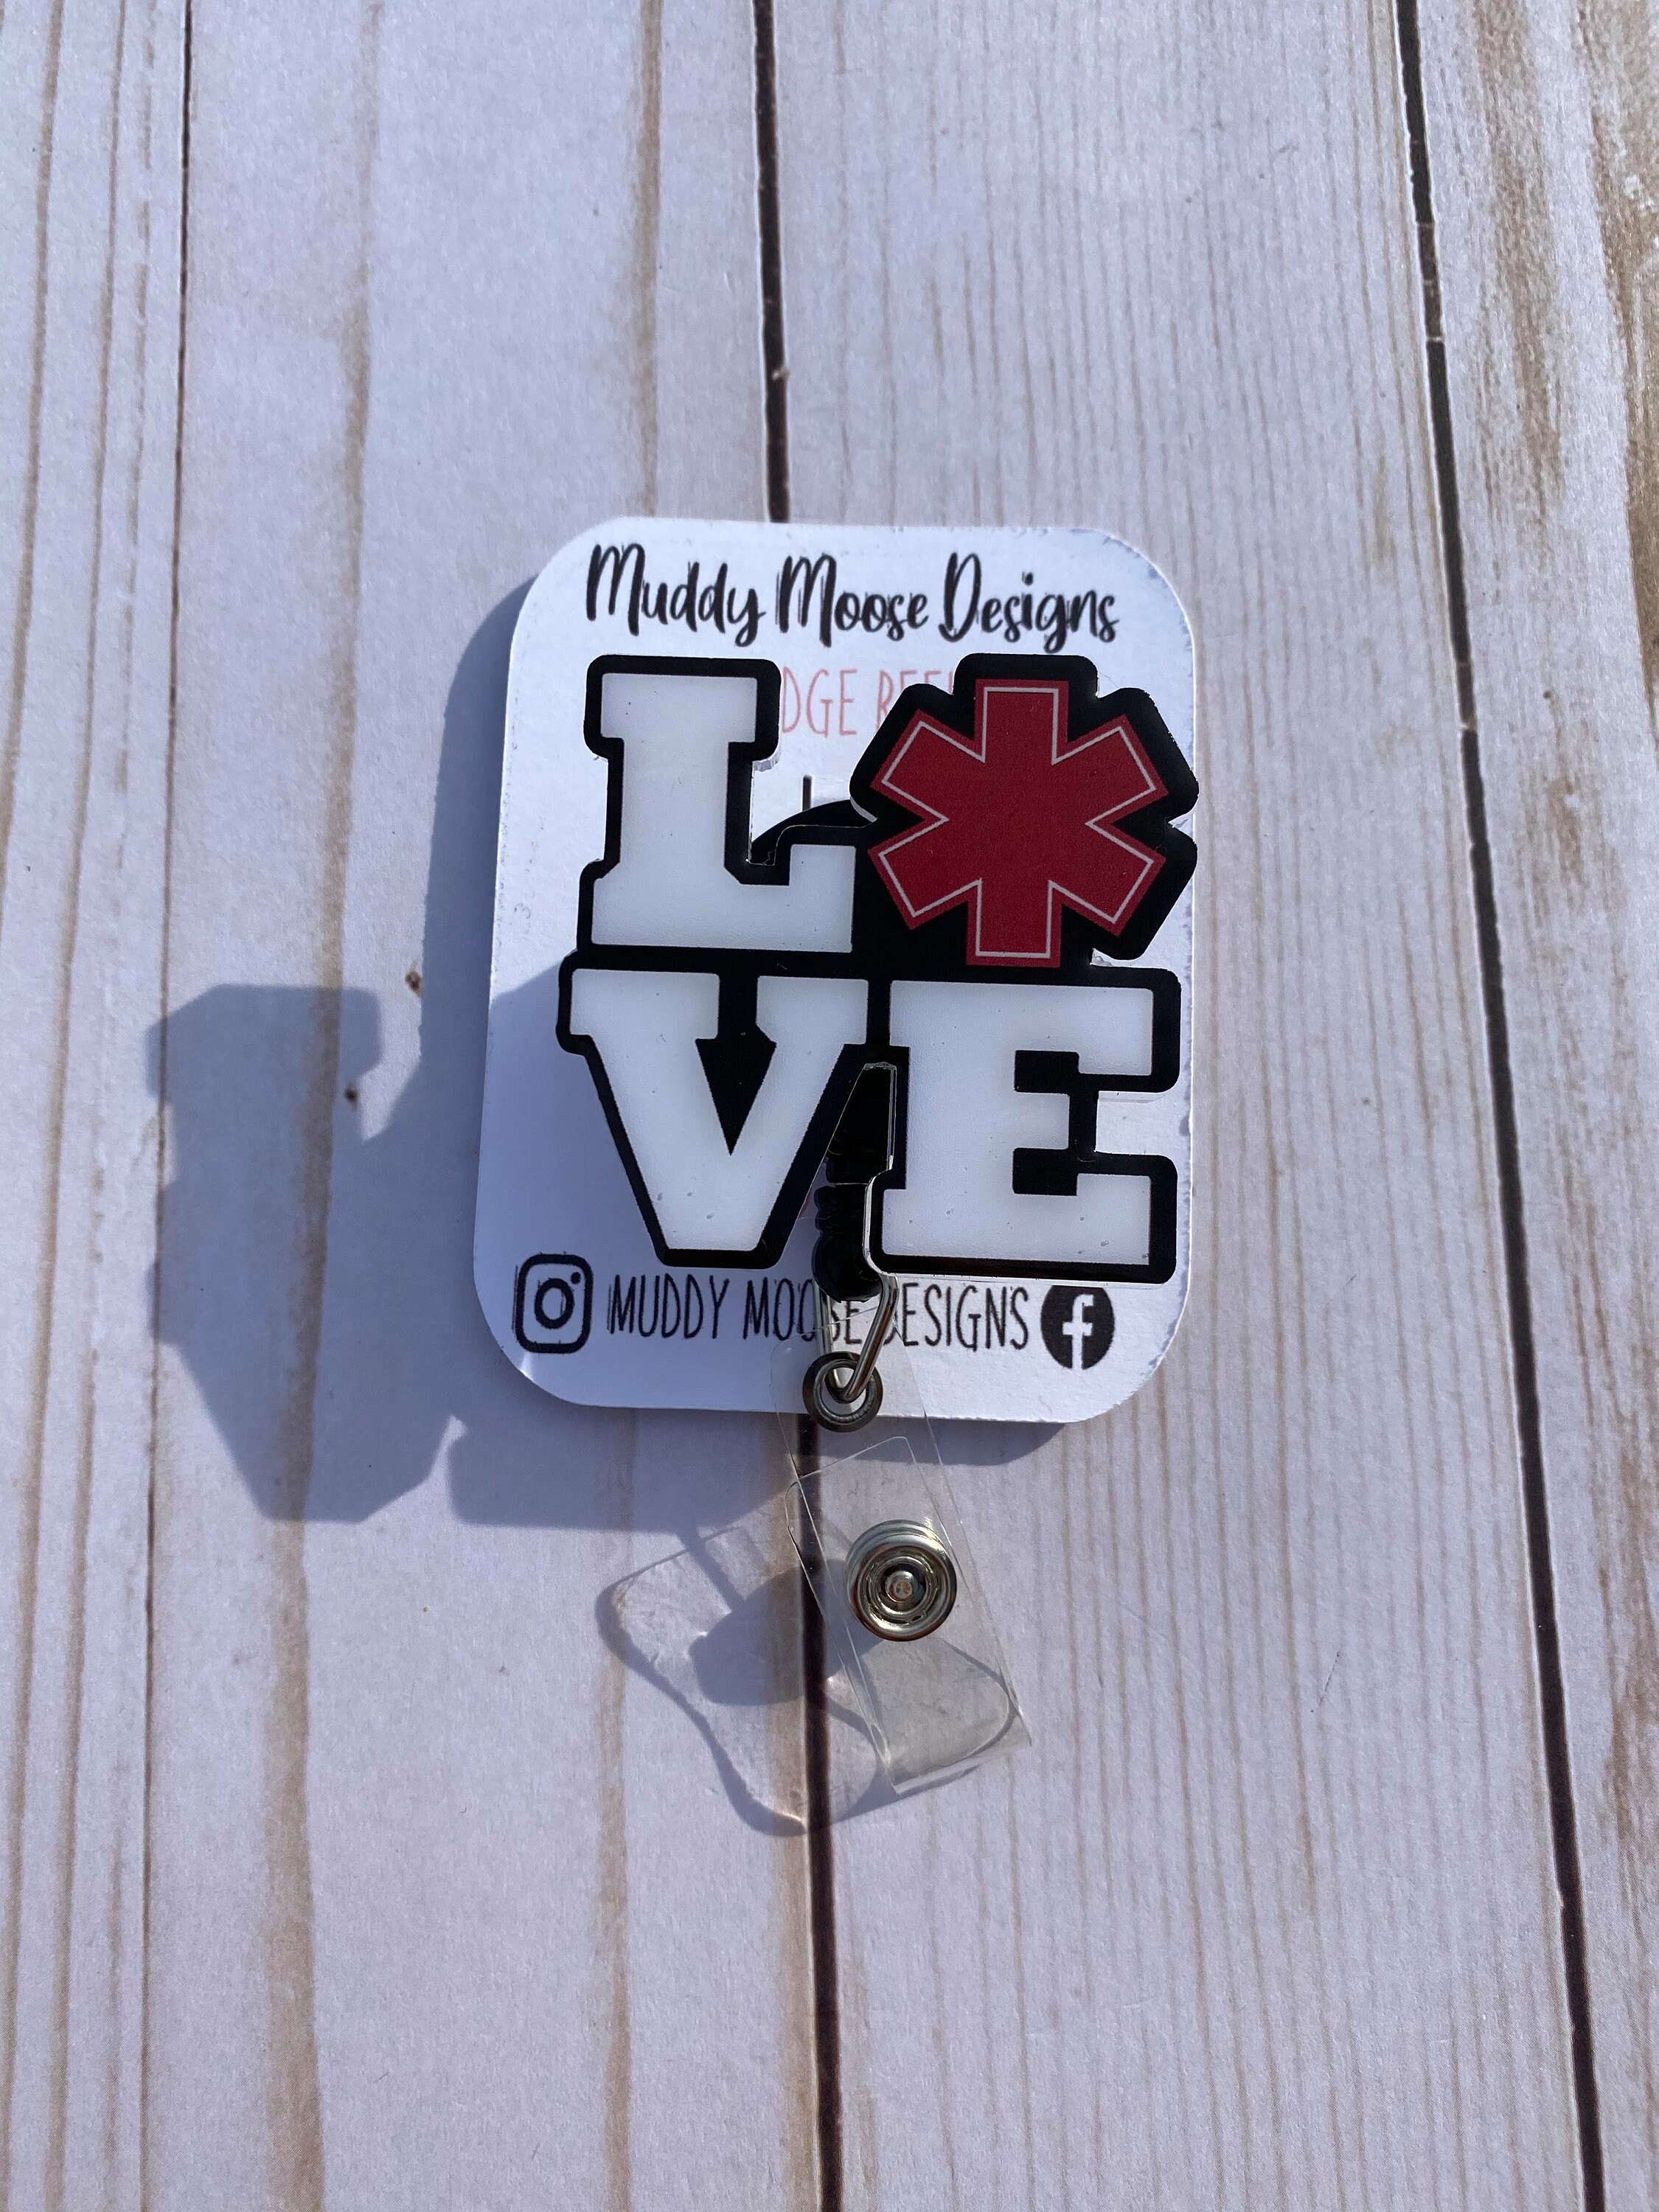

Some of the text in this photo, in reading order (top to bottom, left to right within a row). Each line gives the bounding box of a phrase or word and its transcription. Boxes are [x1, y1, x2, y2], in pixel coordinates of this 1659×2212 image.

[585, 543, 1120, 655] Muddy Moose Designs
[782, 666, 858, 738] DGE
[608, 1273, 729, 1340] MUDDY
